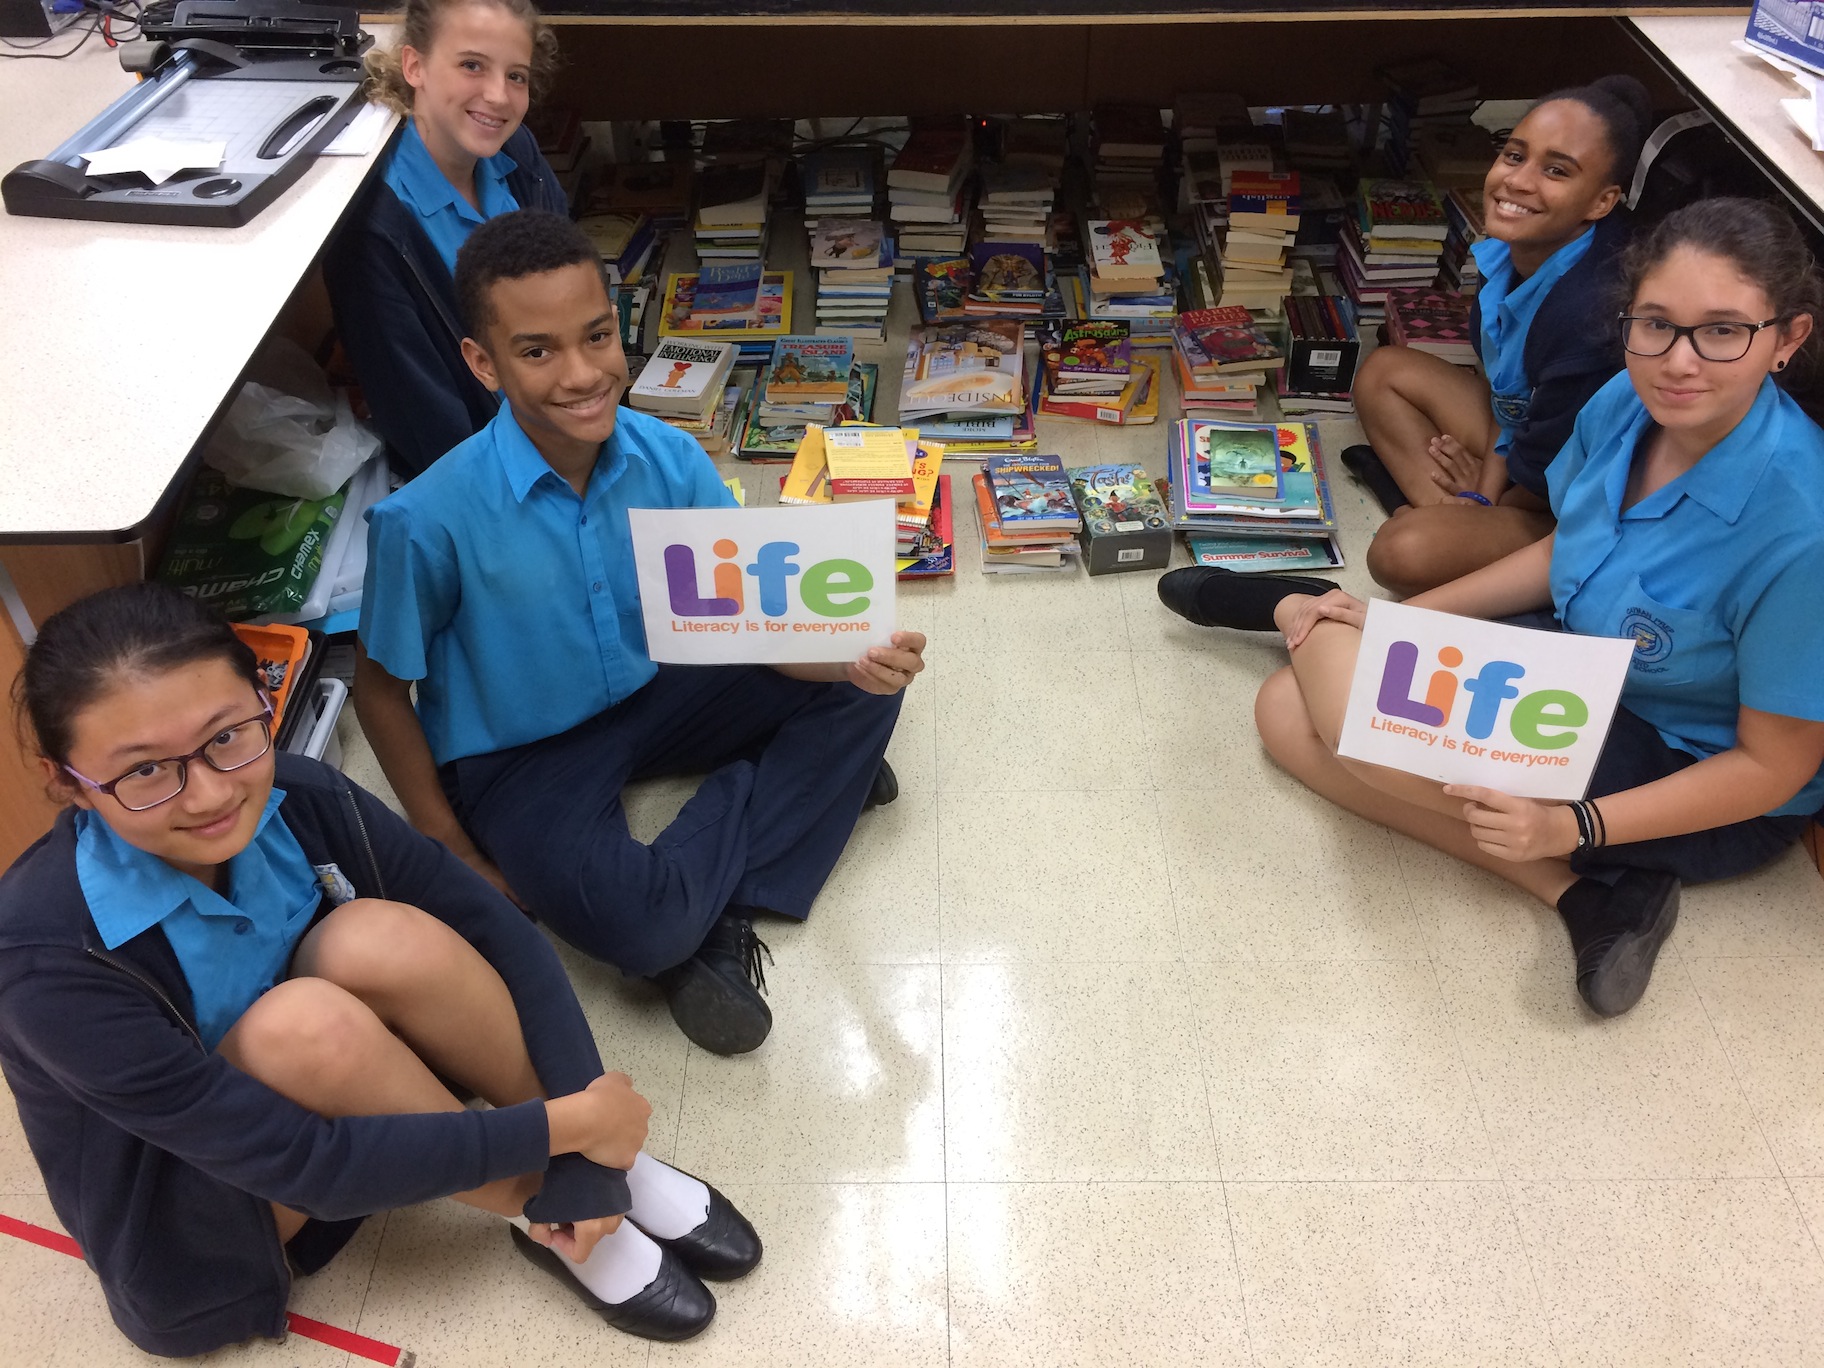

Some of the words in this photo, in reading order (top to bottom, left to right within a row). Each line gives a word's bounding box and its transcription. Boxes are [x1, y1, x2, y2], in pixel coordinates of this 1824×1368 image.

[1187, 306, 1240, 318] HARRY
[1191, 312, 1248, 324] POTTER
[1062, 328, 1129, 342] Astrosaurs
[658, 351, 718, 363] INTELLIGENCE
[662, 344, 720, 357] EMOTIONAL
[995, 465, 1059, 474] SHIPWRECKED!
[1202, 552, 1257, 562] Summer
[1258, 549, 1312, 559] Survival
[664, 538, 874, 617] Life
[671, 620, 740, 634] Literacy
[745, 620, 759, 632] is
[765, 619, 788, 632] for
[793, 620, 871, 635] everyone
[1376, 640, 1589, 750] Life
[1370, 716, 1438, 746] Literacy
[1442, 735, 1457, 750] is
[1462, 741, 1487, 757] for
[1490, 749, 1570, 767] everyone
